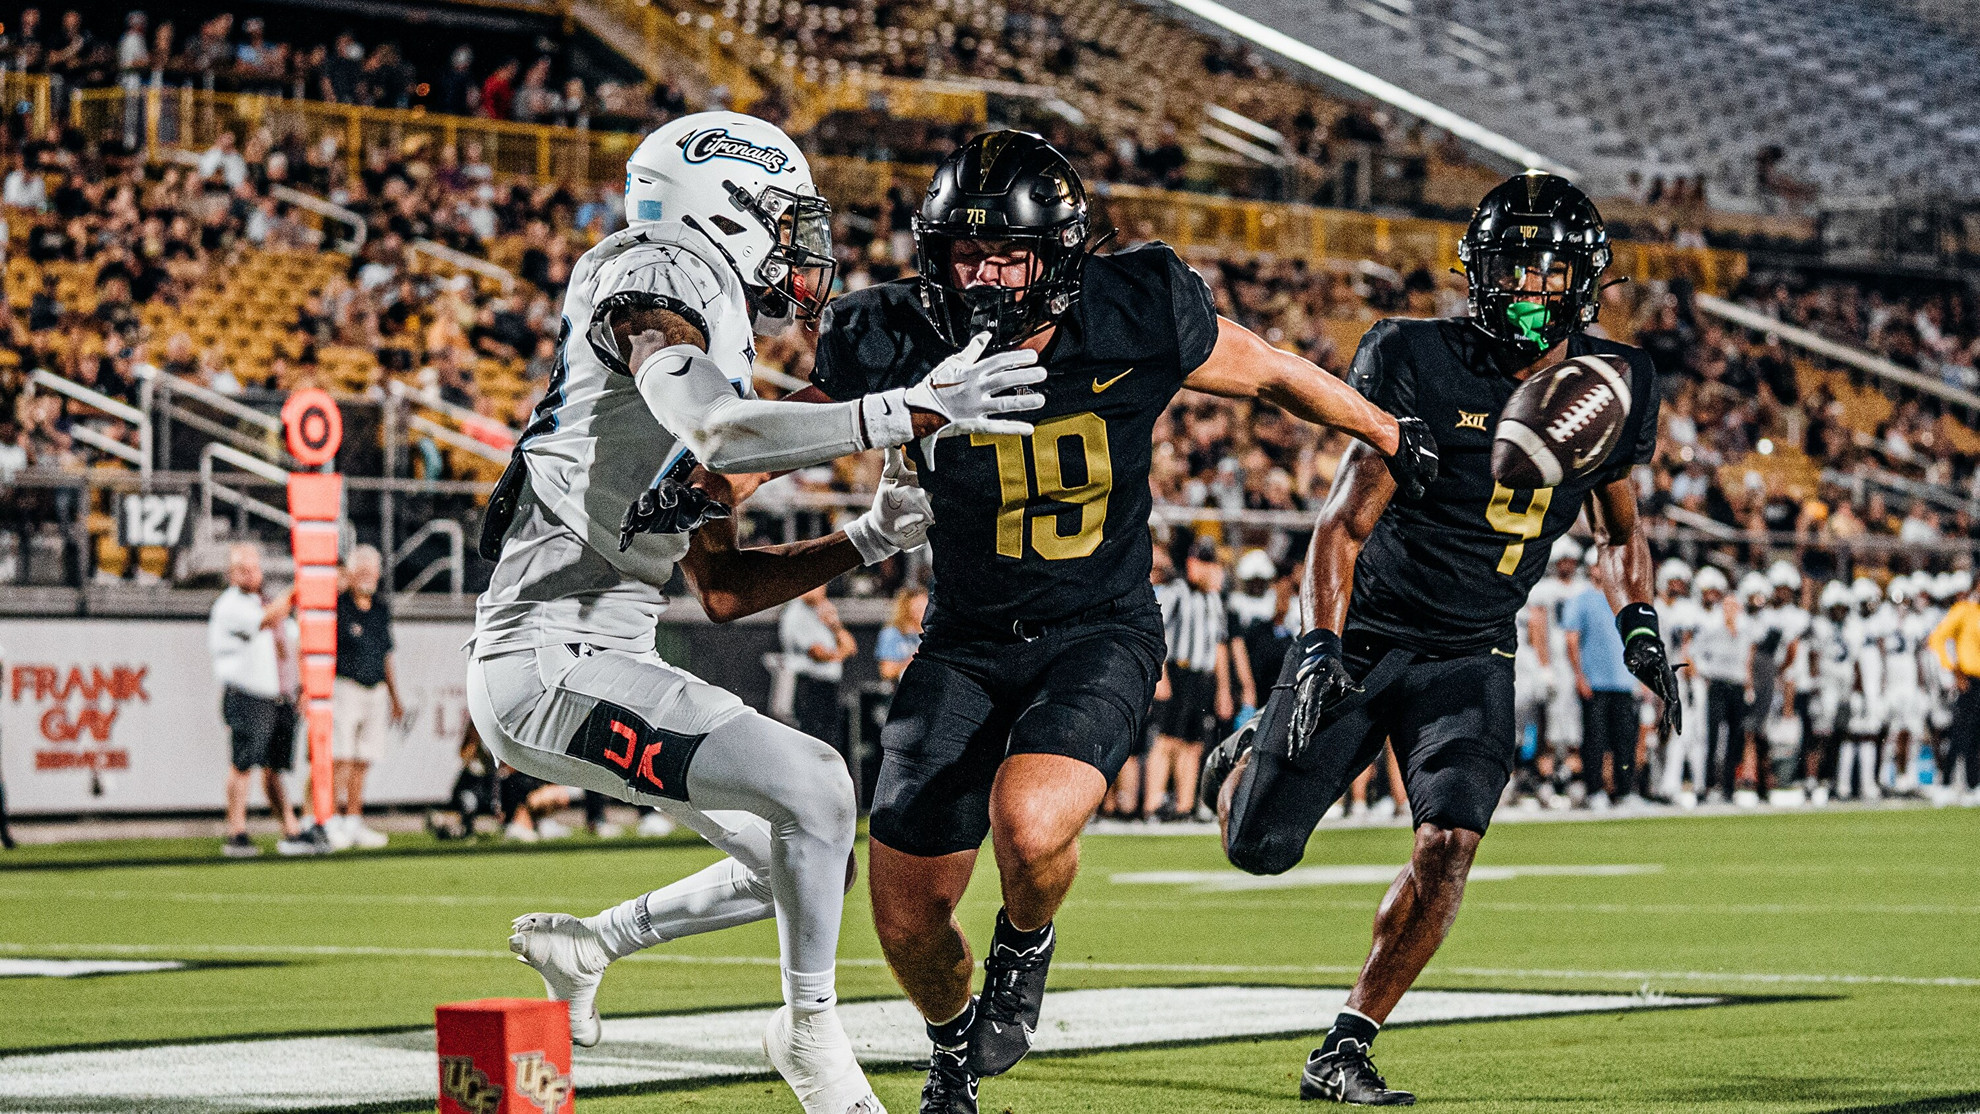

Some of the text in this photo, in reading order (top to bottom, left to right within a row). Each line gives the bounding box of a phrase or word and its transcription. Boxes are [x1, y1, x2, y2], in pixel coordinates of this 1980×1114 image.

[684, 128, 787, 174] Citronauts
[966, 208, 986, 224] 713
[1455, 410, 1489, 431] XII
[969, 411, 1113, 560] 19
[124, 494, 188, 546] 127
[11, 665, 149, 702] FRANK
[39, 707, 118, 741] GAY
[510, 1051, 571, 1114] UCF
